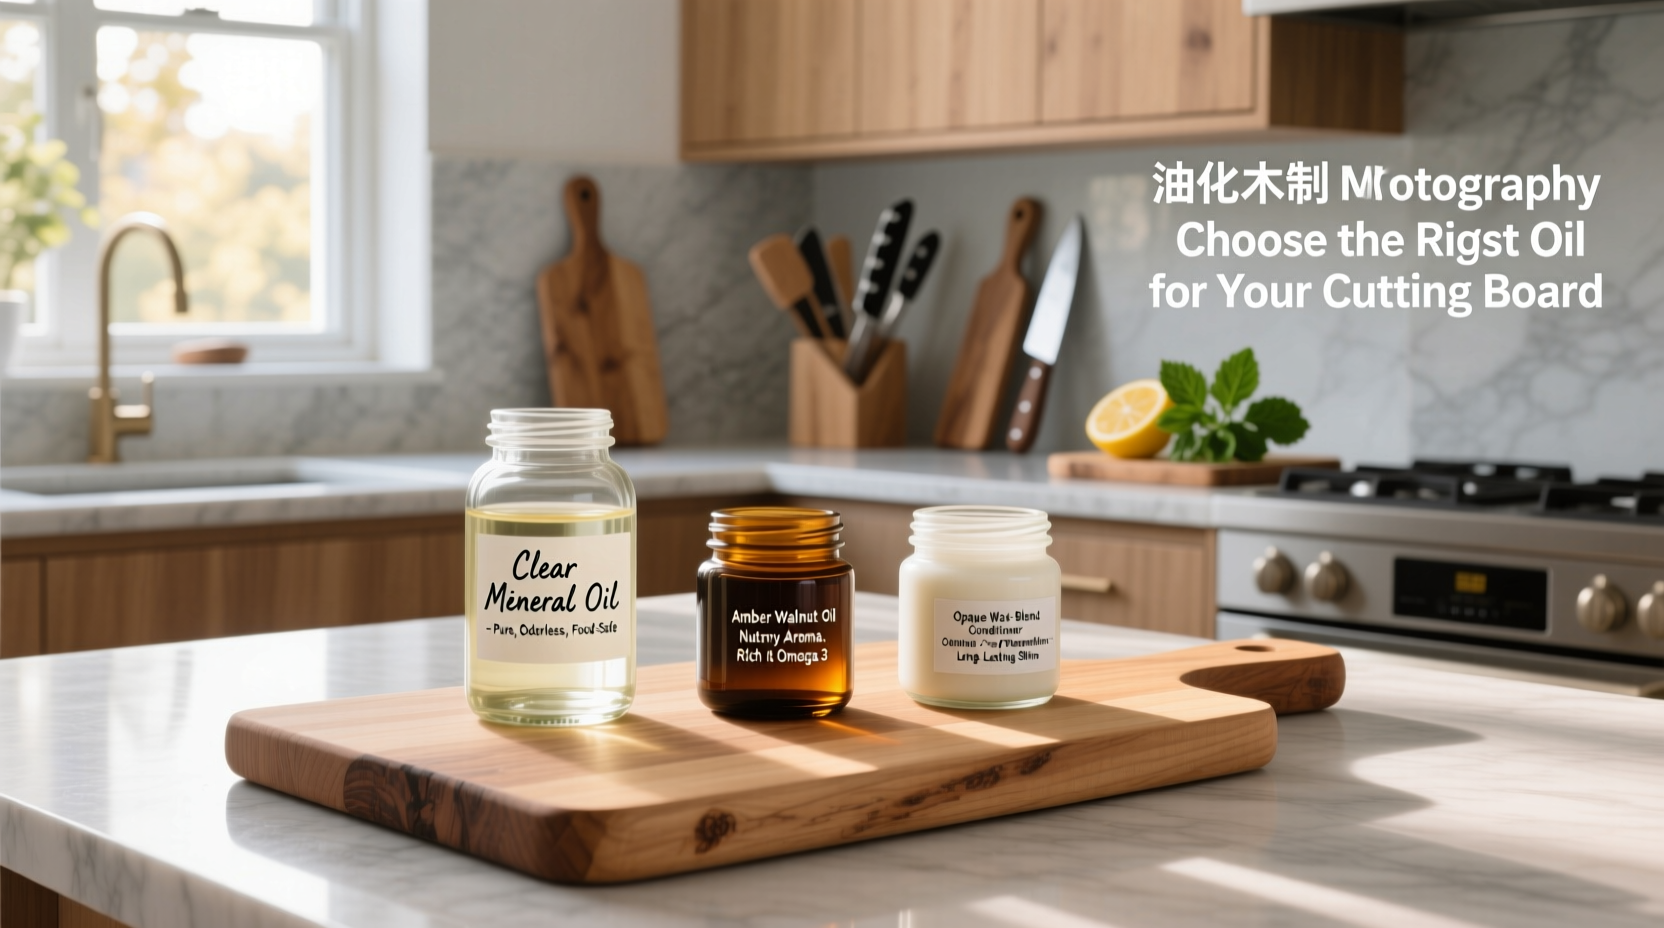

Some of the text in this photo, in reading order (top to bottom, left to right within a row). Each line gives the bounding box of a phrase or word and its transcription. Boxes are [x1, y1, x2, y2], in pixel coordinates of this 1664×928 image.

[513, 549, 578, 580] Clear
[585, 580, 620, 613] Oil
[731, 608, 772, 624] Amber
[774, 608, 818, 624] Walnut
[821, 647, 828, 661] 3
